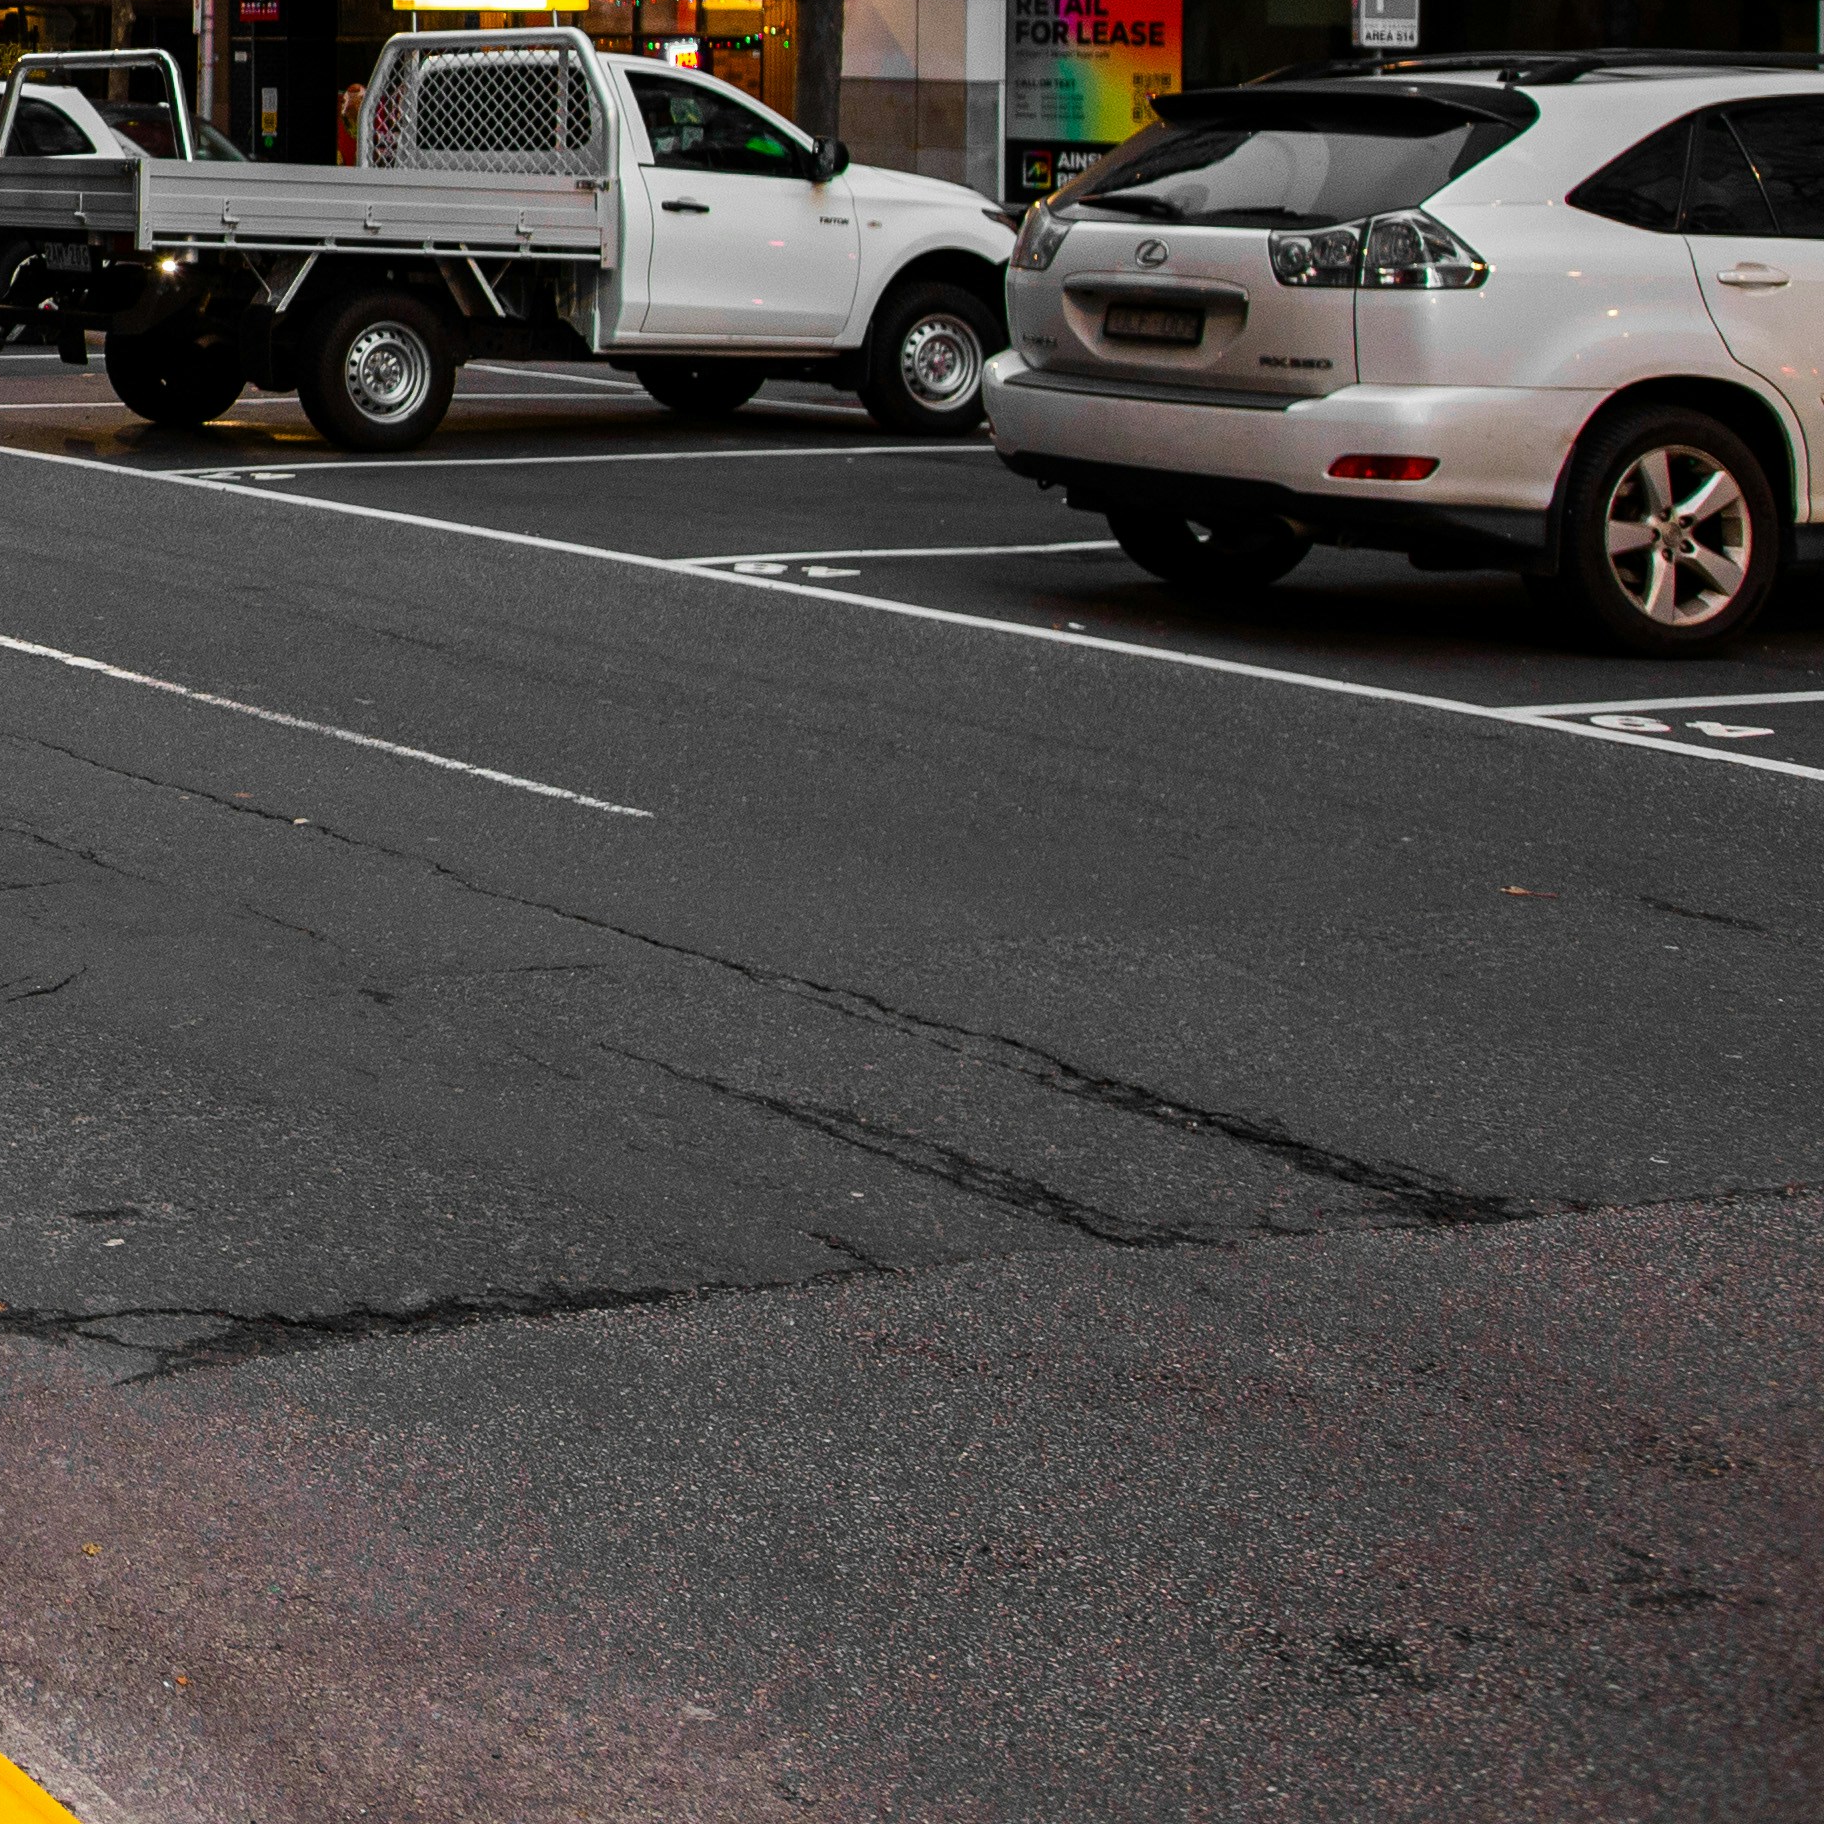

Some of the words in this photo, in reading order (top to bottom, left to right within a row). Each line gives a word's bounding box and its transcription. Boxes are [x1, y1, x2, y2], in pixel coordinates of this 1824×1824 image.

[1015, 20, 1069, 44] FOR
[1077, 21, 1165, 46] LEASE
[1365, 31, 1393, 41] AREA
